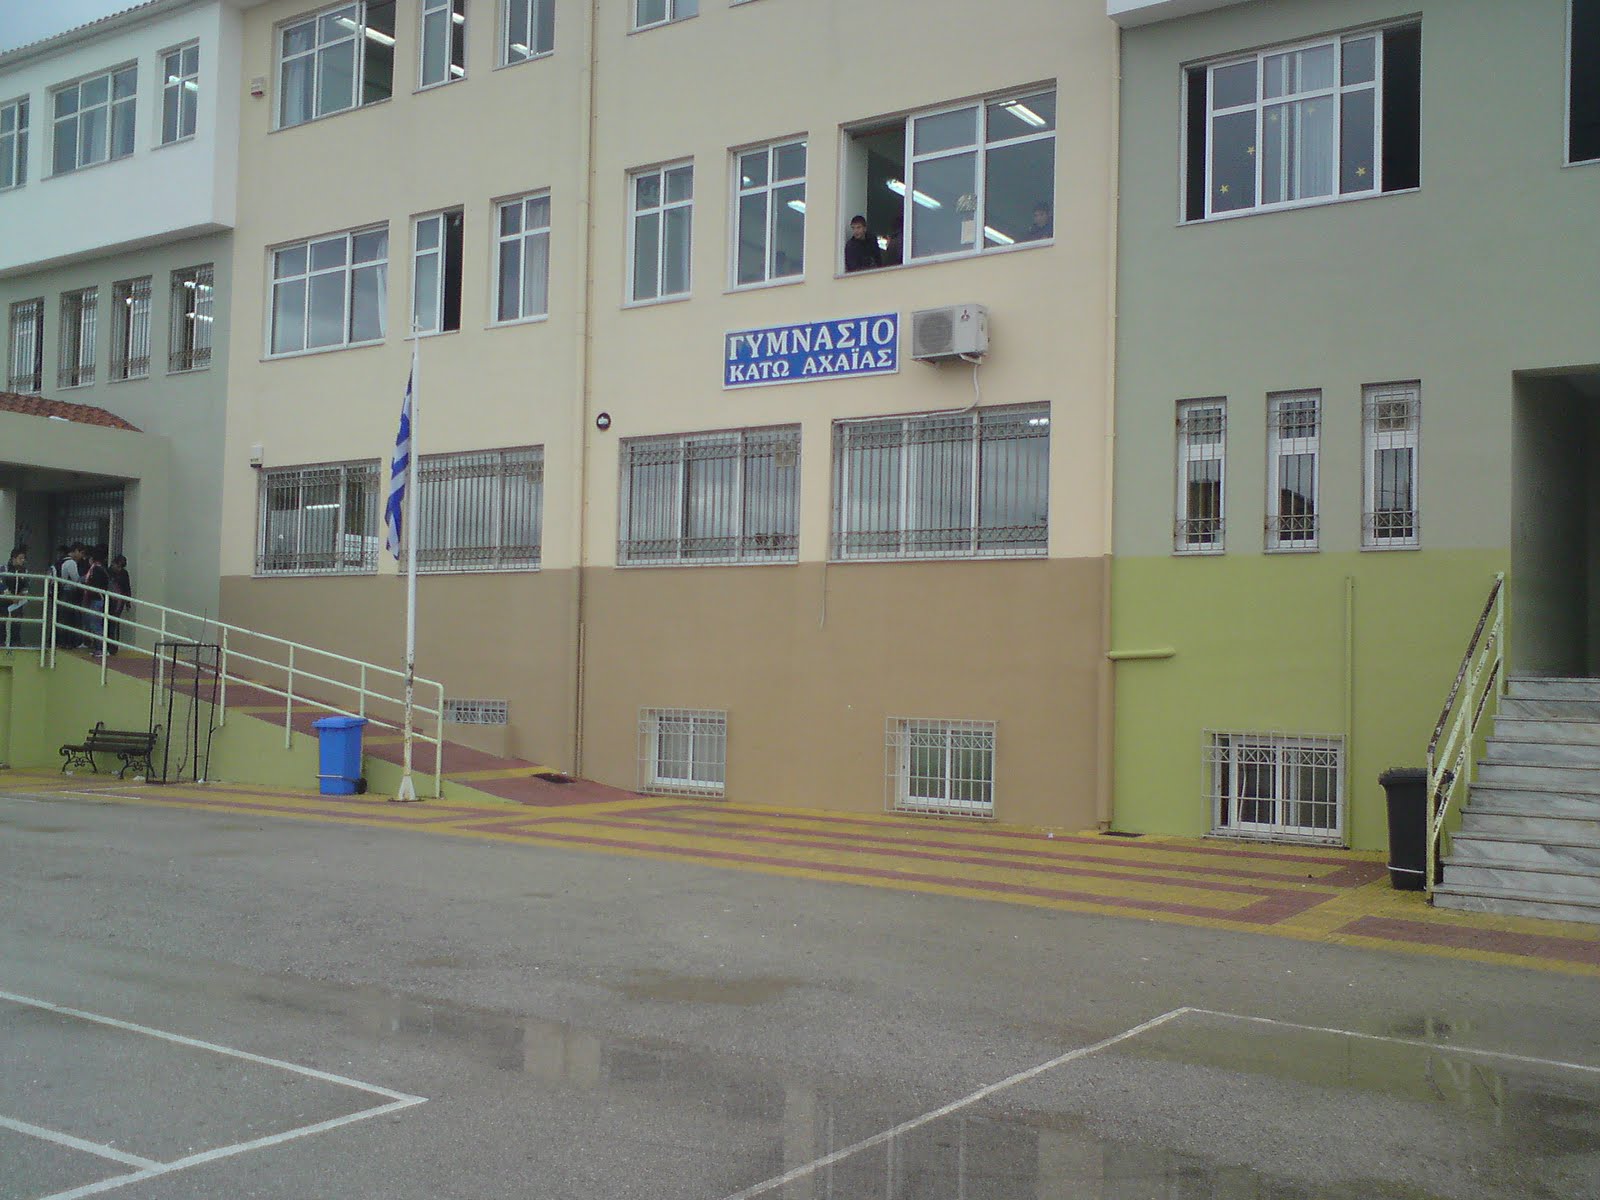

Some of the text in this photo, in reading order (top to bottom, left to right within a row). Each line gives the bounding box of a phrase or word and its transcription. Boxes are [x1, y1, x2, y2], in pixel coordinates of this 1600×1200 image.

[729, 318, 894, 360] ΓΥΜΝΑΣΙΟ
[730, 348, 892, 382] ΚΑΤΩ ΑΧΑΪΑΣ
